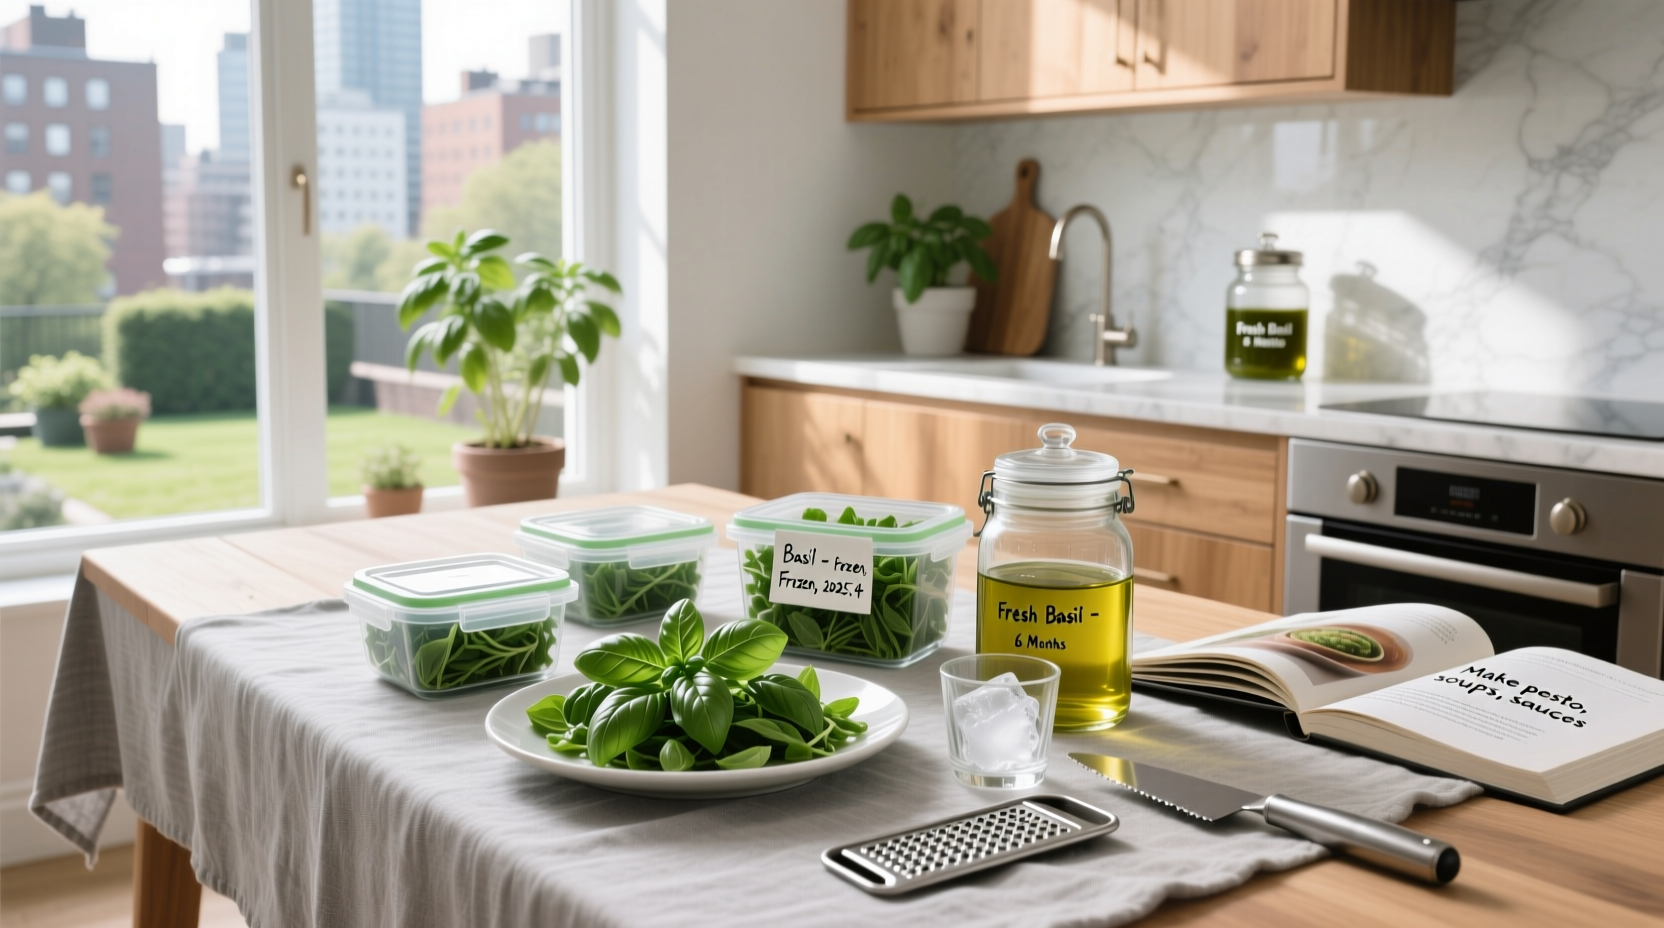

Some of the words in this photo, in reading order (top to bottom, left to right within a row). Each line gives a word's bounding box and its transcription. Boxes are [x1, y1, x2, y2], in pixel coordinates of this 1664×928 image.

[783, 543, 816, 566] Basil
[998, 601, 1037, 624] Fresh
[1045, 604, 1083, 624] Basil
[1014, 632, 1023, 648] 6
[1433, 674, 1503, 701] soups,
[1459, 665, 1520, 688] Make
